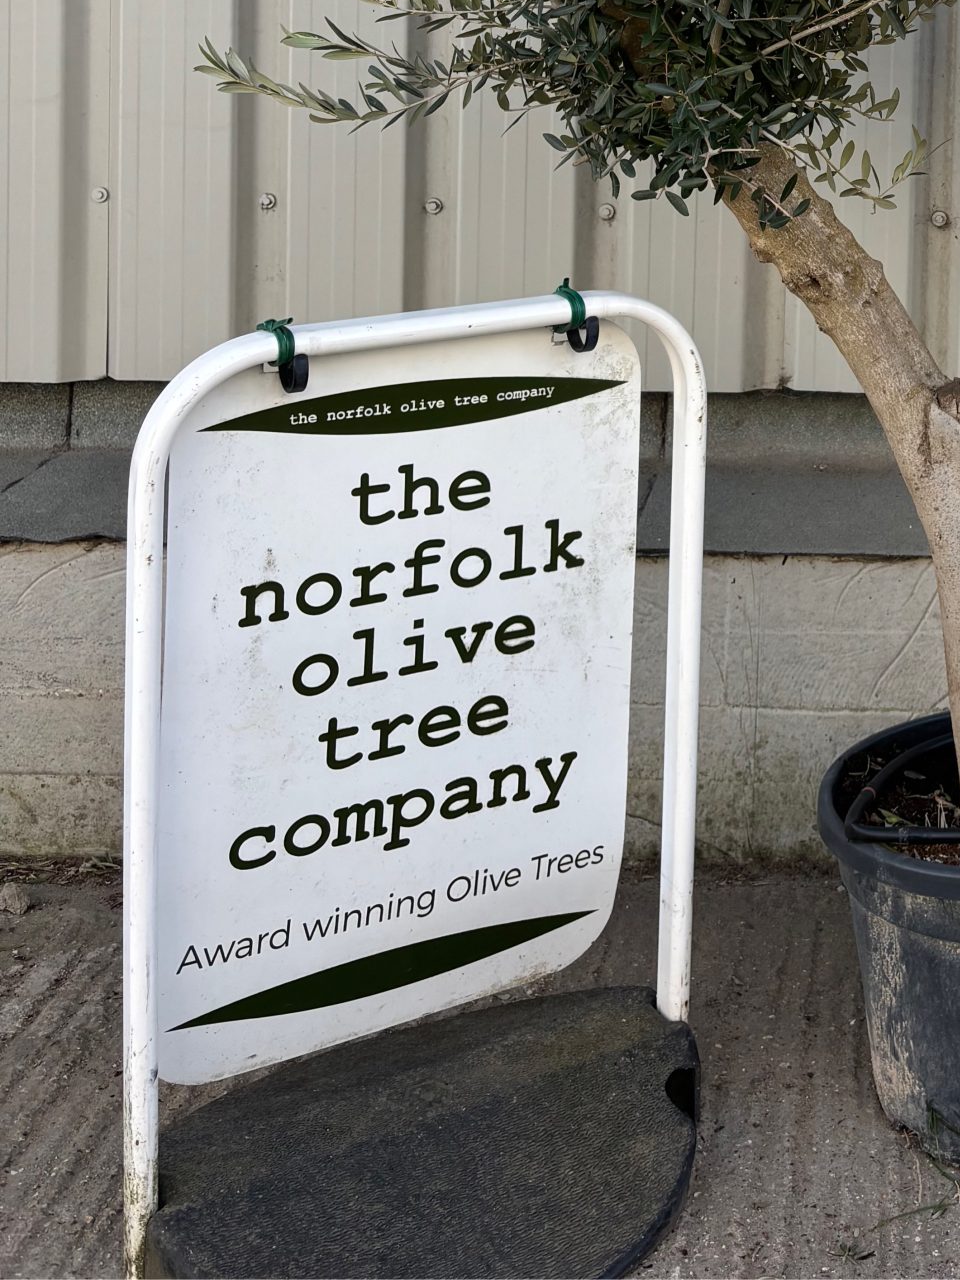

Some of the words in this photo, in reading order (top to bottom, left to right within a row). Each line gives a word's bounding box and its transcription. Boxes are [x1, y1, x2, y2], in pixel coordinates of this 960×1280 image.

[289, 412, 318, 426] the
[326, 403, 392, 422] norfolk
[400, 400, 445, 413] olive
[454, 394, 489, 407] tree
[496, 386, 555, 402] company
[350, 463, 491, 526] the
[238, 518, 585, 628] norfolk
[292, 614, 536, 697] olive
[318, 695, 509, 770] tree
[228, 751, 578, 871] company
[176, 919, 292, 975] Award
[302, 889, 436, 942] winning
[446, 867, 522, 903] Olive
[531, 845, 604, 881] Trees
